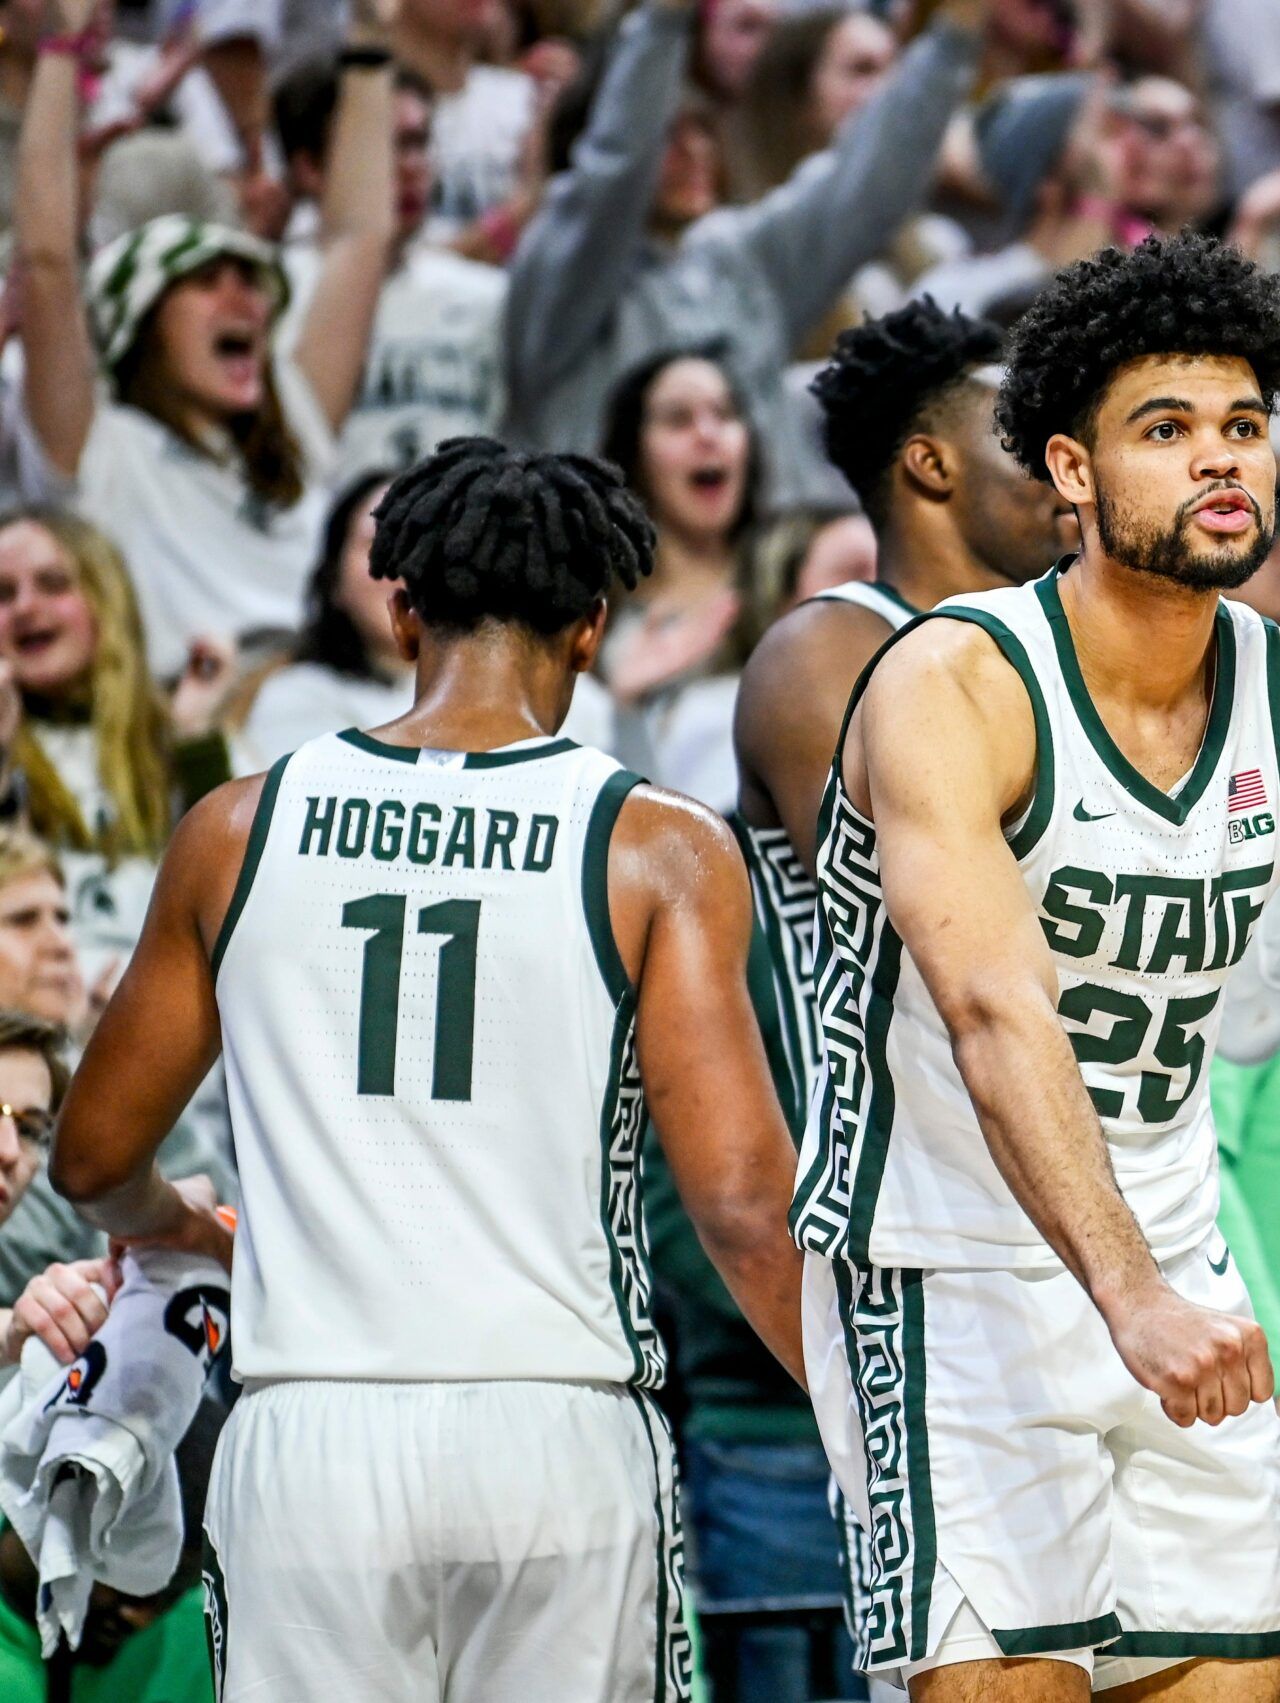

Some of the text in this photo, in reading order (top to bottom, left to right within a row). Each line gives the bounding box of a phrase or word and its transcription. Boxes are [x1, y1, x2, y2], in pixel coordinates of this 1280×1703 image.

[298, 796, 560, 873] HOGGARD
[1038, 861, 1275, 974] STATE
[341, 893, 482, 1102] 11
[1057, 982, 1223, 1124] 25
